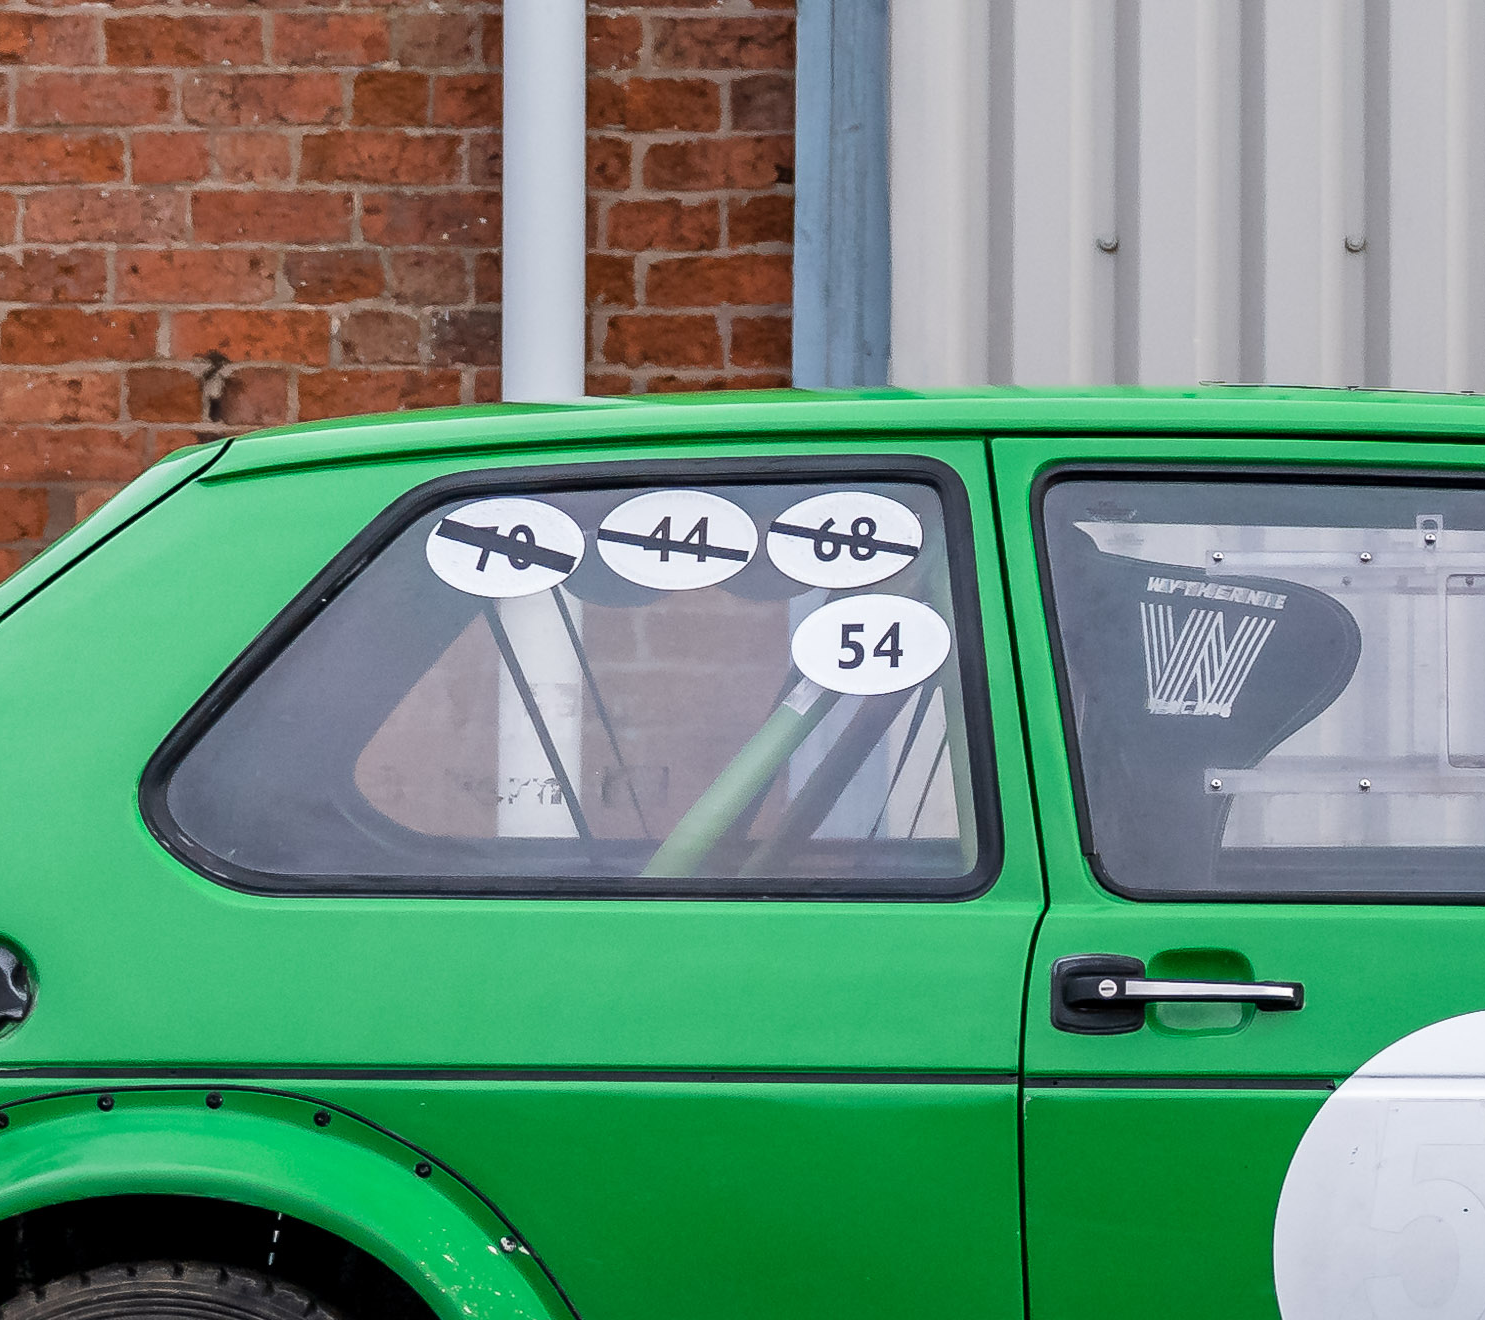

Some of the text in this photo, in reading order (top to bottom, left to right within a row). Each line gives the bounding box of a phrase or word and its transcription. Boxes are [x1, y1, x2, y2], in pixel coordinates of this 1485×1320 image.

[644, 516, 710, 562] 44
[813, 517, 877, 562] 68
[838, 622, 904, 670] 54
